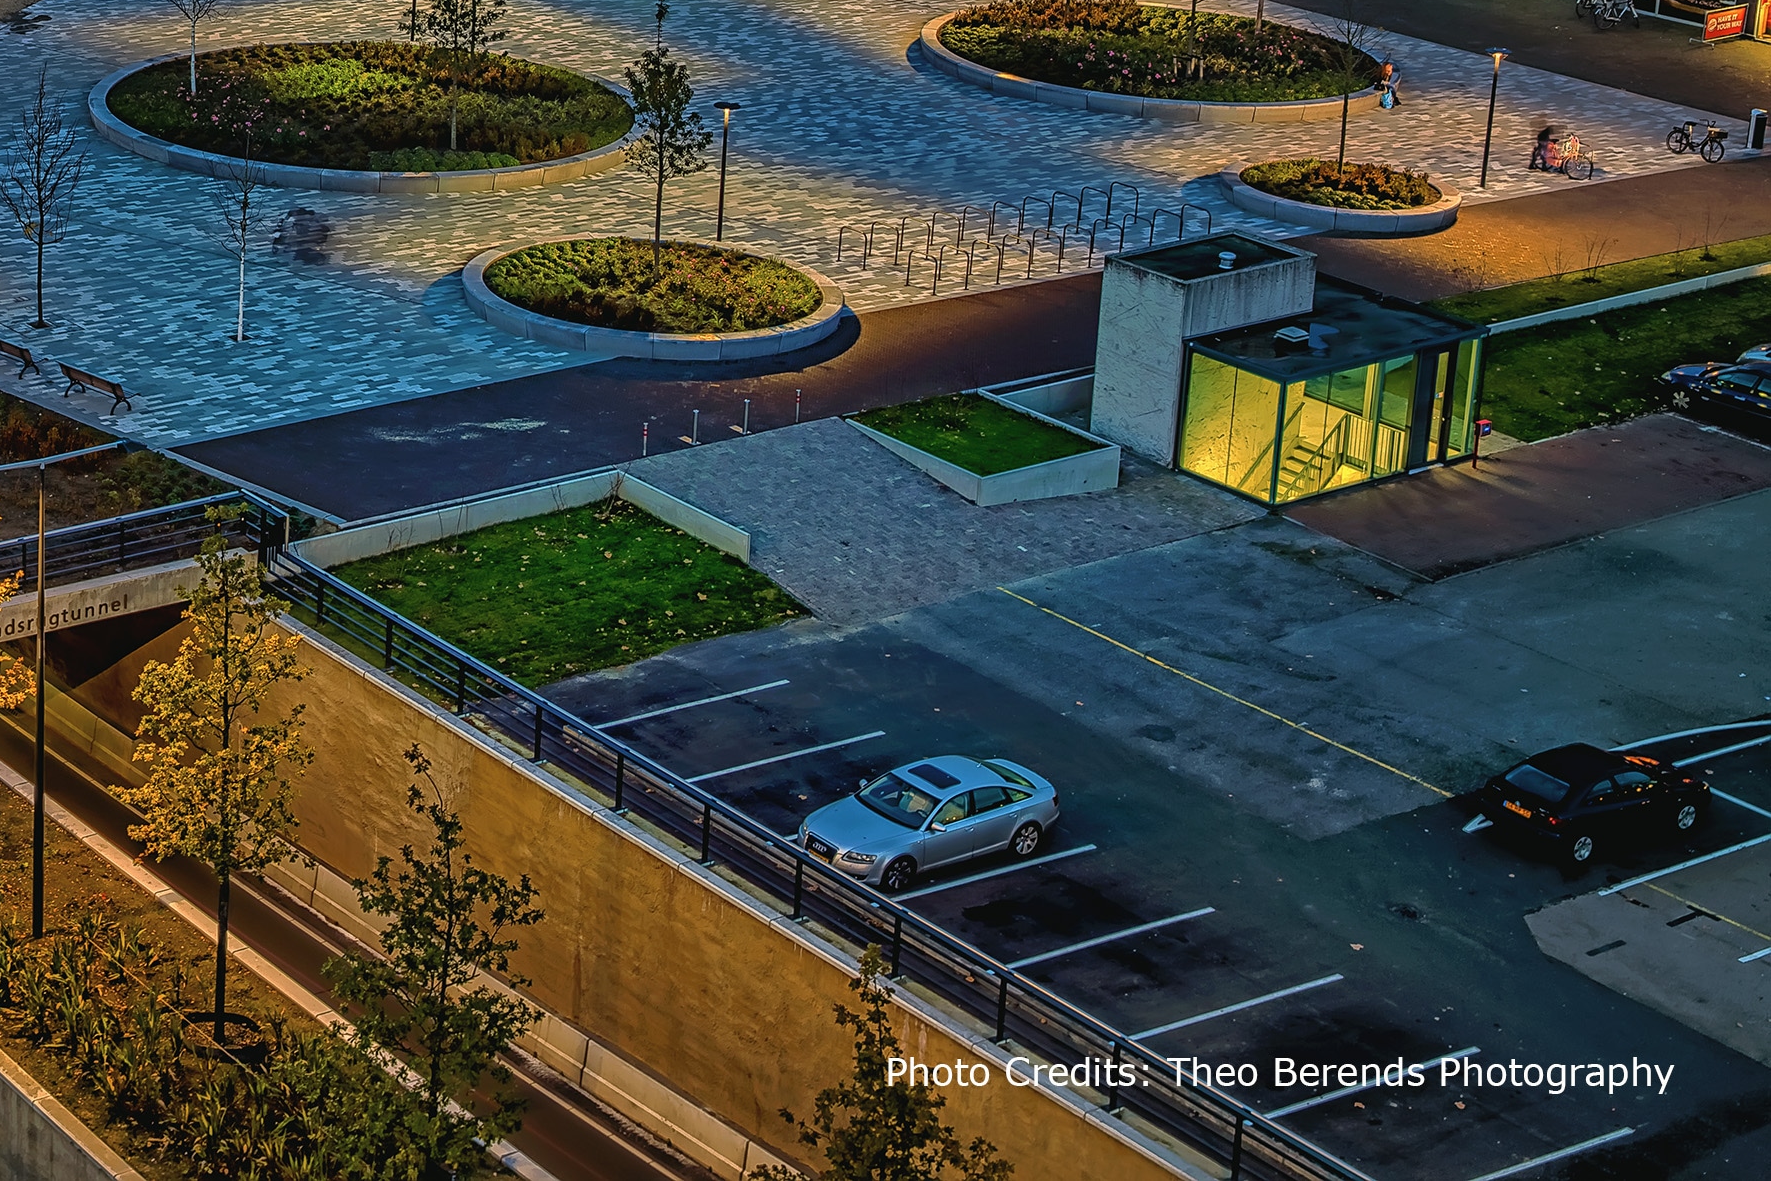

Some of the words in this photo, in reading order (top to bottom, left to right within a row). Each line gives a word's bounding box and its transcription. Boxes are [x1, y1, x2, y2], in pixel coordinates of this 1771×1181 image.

[1717, 15, 1731, 23] HAVE
[1732, 13, 1739, 21] IT
[1717, 22, 1731, 31] YOUR
[1731, 19, 1743, 28] WAY
